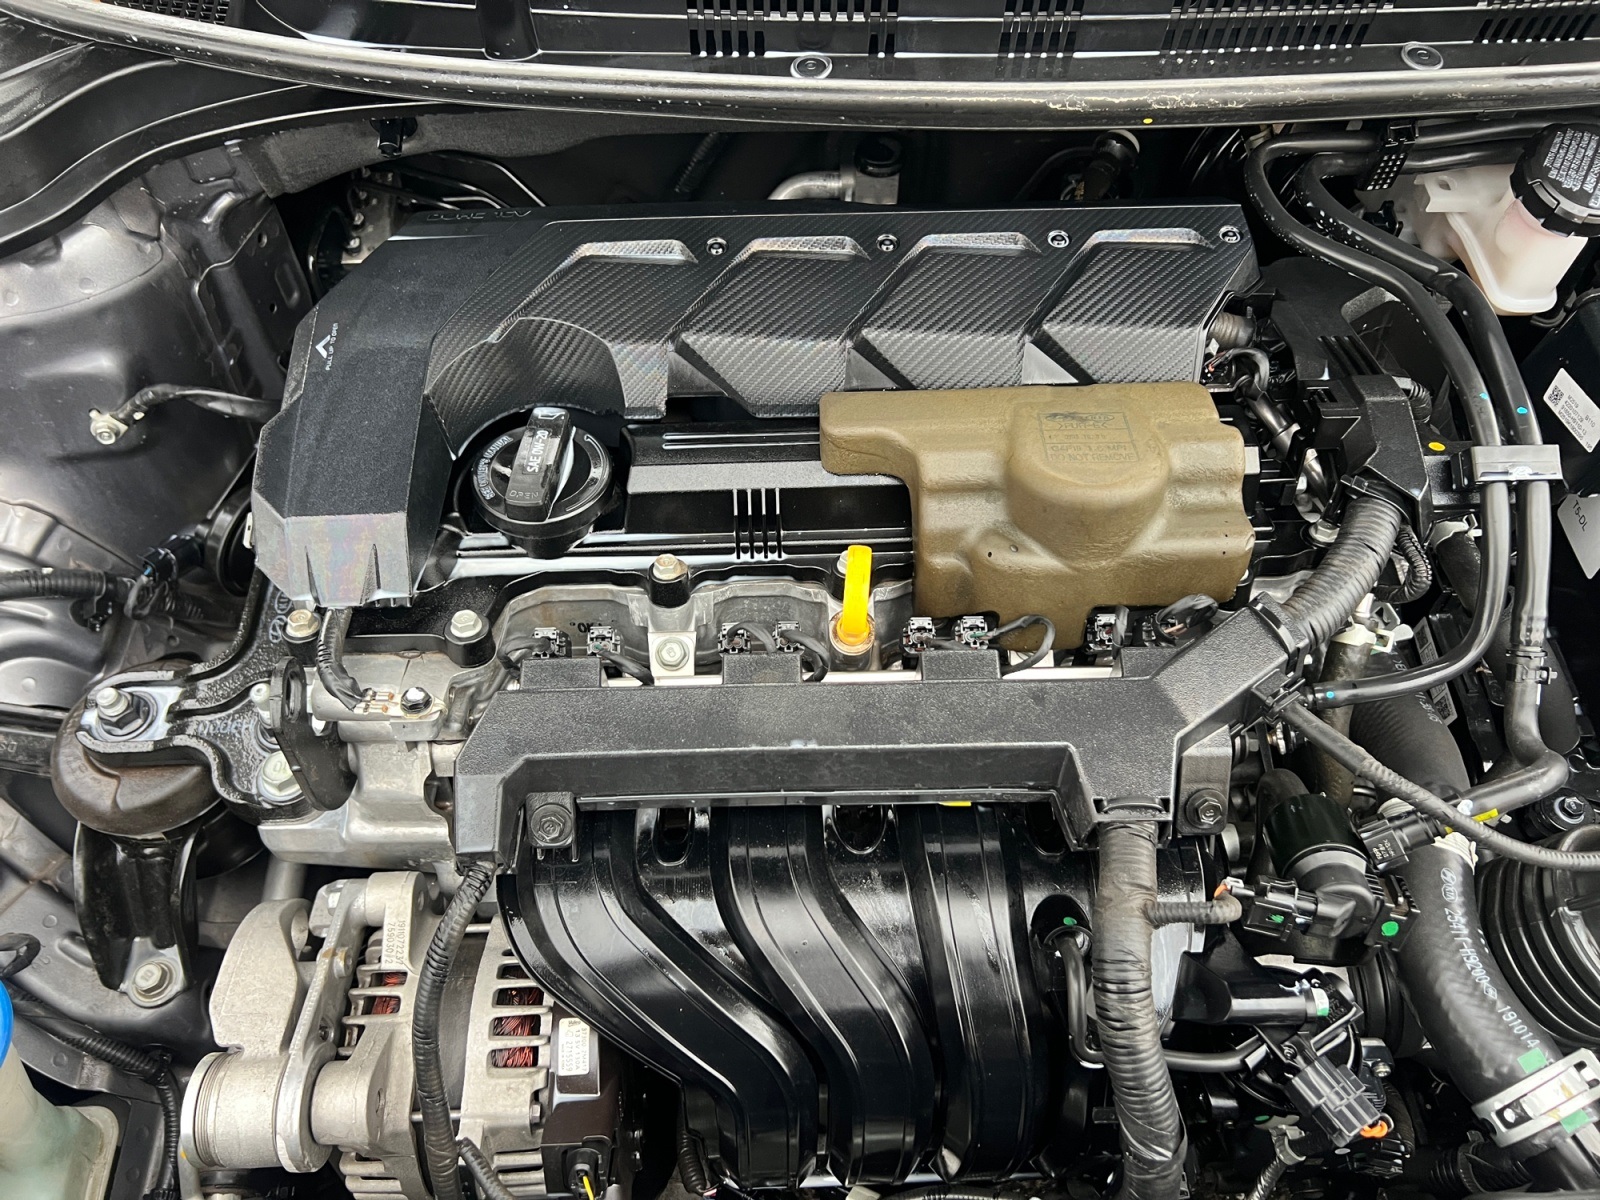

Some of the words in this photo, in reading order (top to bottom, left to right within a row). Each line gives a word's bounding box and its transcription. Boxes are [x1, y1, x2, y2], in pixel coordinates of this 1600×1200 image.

[482, 435, 513, 459] MANUAL
[532, 430, 549, 455] 0W-20
[526, 455, 542, 473] SAE
[479, 486, 495, 500] SEE
[1444, 907, 1491, 984] 25411-H9200
[1498, 1005, 1541, 1049] 191014
